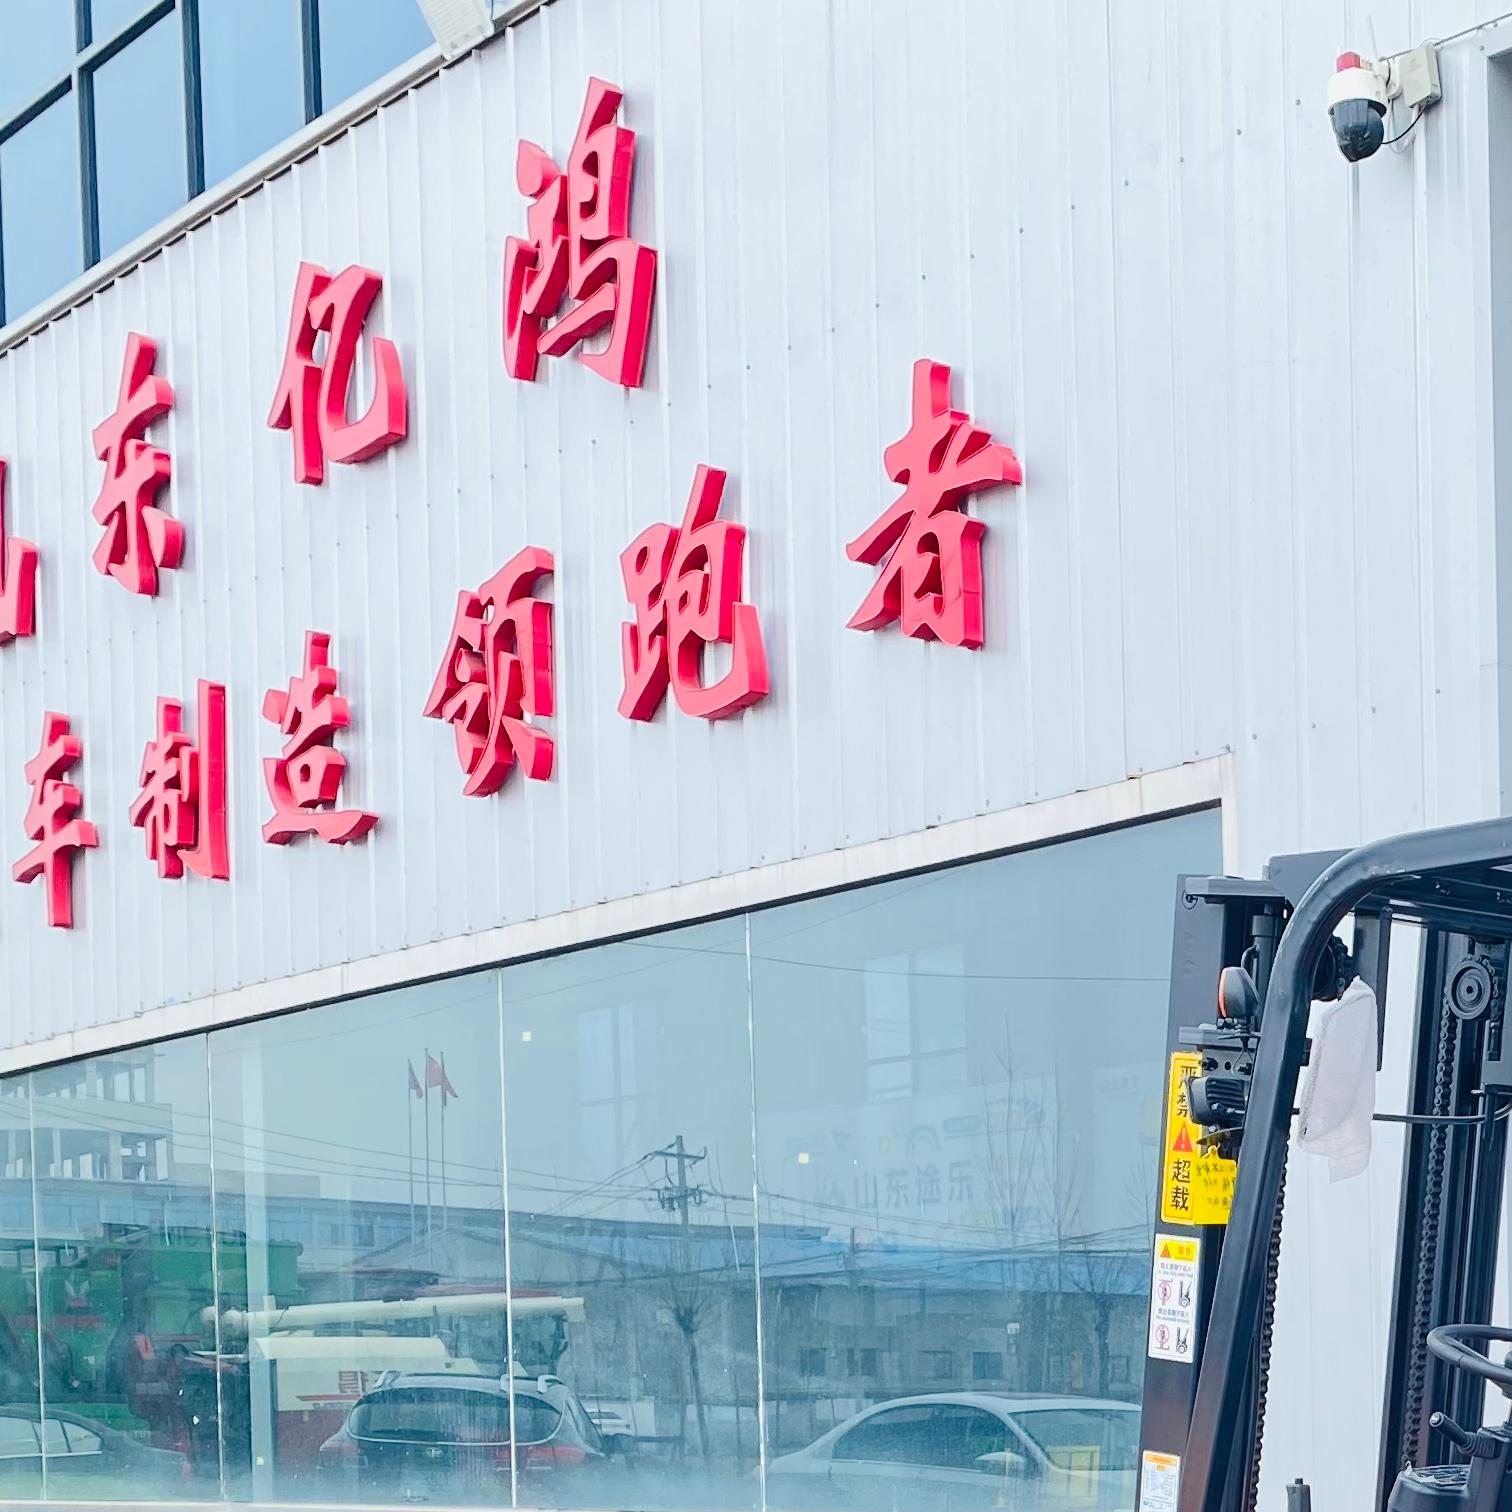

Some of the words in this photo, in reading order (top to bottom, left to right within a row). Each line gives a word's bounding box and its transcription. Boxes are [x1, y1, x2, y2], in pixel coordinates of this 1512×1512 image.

[12, 358, 1022, 929] 车制造领跑者
[1171, 1160, 1191, 1211] 超载
